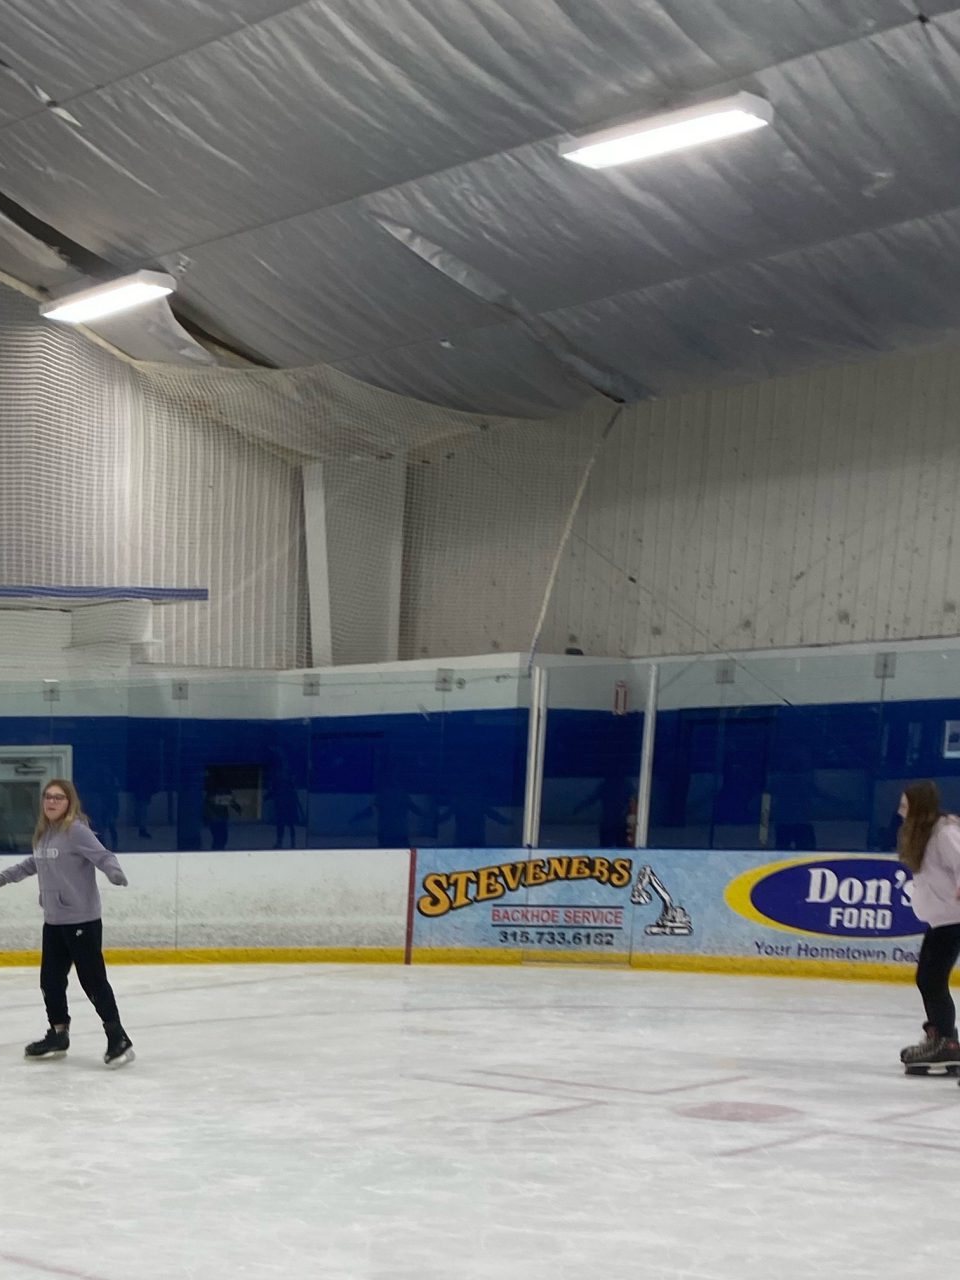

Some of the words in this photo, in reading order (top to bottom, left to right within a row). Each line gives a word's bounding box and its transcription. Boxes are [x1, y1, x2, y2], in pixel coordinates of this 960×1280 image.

[417, 856, 632, 917] STEVENERS
[492, 909, 559, 923] BACKHOE
[564, 910, 623, 925] SERVICE
[829, 907, 892, 929] FORD
[755, 941, 790, 956] Your
[797, 943, 886, 961] Hometown
